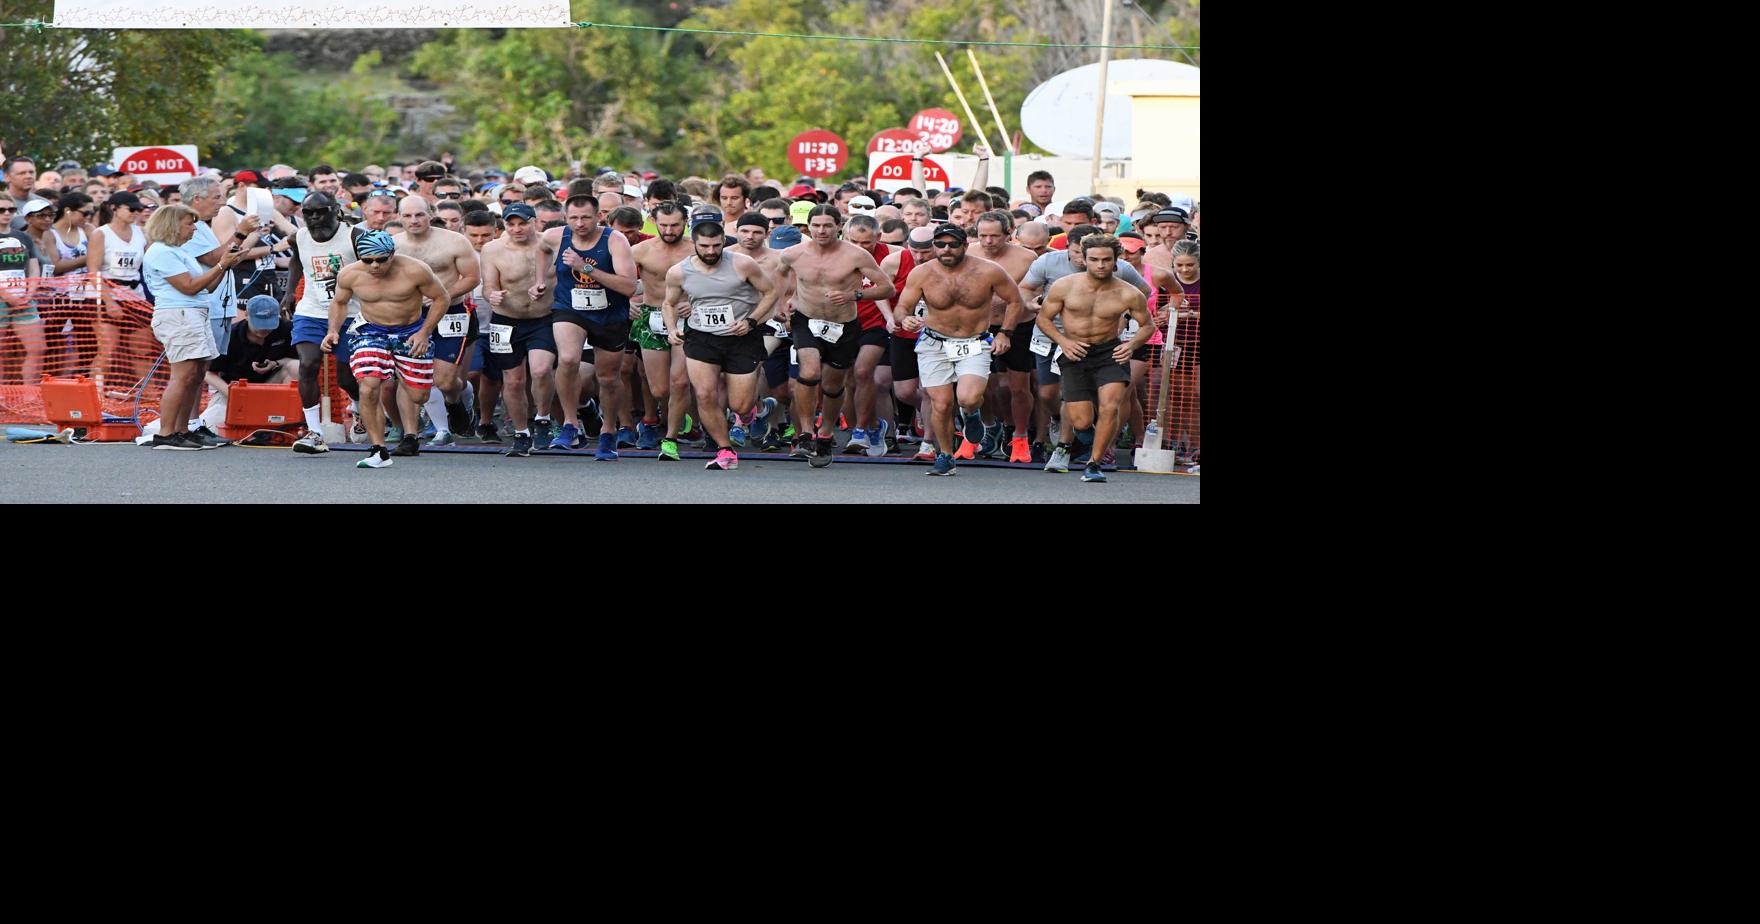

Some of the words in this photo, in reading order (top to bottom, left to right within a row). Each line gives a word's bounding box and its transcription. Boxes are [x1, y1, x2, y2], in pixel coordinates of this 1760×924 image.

[916, 115, 959, 133] 14:20
[798, 142, 839, 154] 11:20
[127, 160, 148, 171] DO
[155, 158, 184, 170] NOT
[805, 158, 837, 173] 1:35
[882, 165, 903, 177] DO
[919, 167, 940, 178] OT
[117, 257, 134, 268] 494
[585, 296, 592, 307] 1
[705, 313, 726, 325] 784
[449, 321, 462, 333] 49
[821, 324, 830, 335] 8
[955, 344, 970, 356] 26
